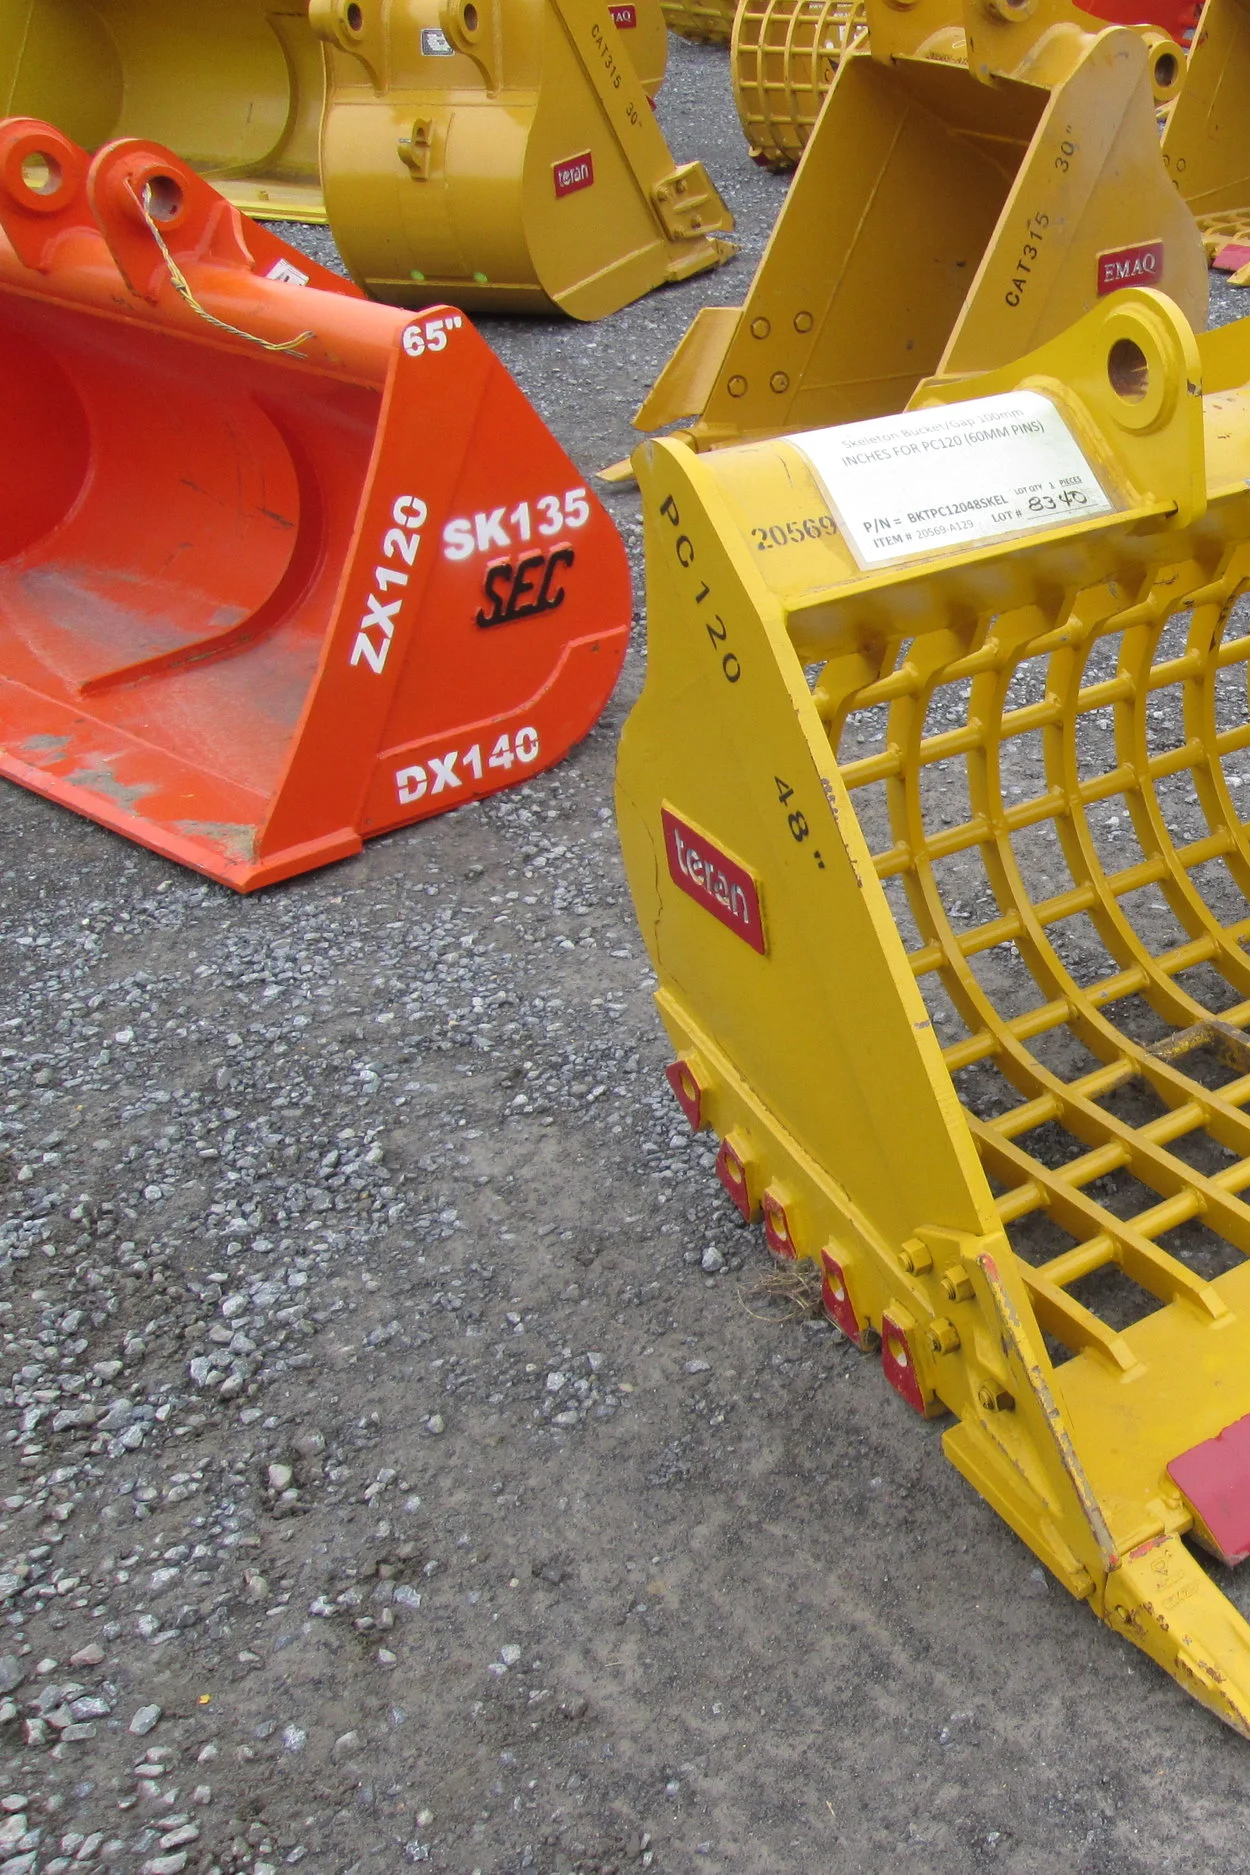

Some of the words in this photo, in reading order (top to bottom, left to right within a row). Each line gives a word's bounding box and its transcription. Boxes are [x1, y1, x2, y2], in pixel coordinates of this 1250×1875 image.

[611, 10, 632, 22] AQ
[591, 24, 621, 89] CAT315
[558, 164, 588, 187] teran
[1005, 211, 1049, 308] CAT315
[1103, 253, 1156, 282] EMAQ
[403, 316, 462, 357] 65"
[841, 432, 899, 449] Skeleton
[900, 417, 976, 438] Bucket/Gap
[978, 407, 1024, 424] 100mm
[841, 446, 892, 467] INCHES
[893, 440, 921, 457] FOR
[923, 435, 962, 452] PC120
[964, 425, 1011, 446] (60MM
[1013, 419, 1045, 437] PINS)
[1014, 484, 1027, 495] LOT
[1028, 483, 1043, 493] QTY
[1059, 475, 1083, 487] PIECES
[443, 487, 590, 561] SK135
[751, 515, 838, 551] 20569
[863, 517, 891, 534] P/N
[907, 493, 1009, 524] BKTPC12048SKEL
[873, 534, 903, 549] ITEM
[905, 533, 913, 541] #
[916, 519, 974, 539] 20569-A129
[991, 509, 1014, 524] LOT
[350, 495, 428, 674] ZX120
[475, 546, 575, 628] SEC
[660, 494, 741, 684] PC120
[396, 726, 540, 805] DX140
[674, 828, 749, 924] teran
